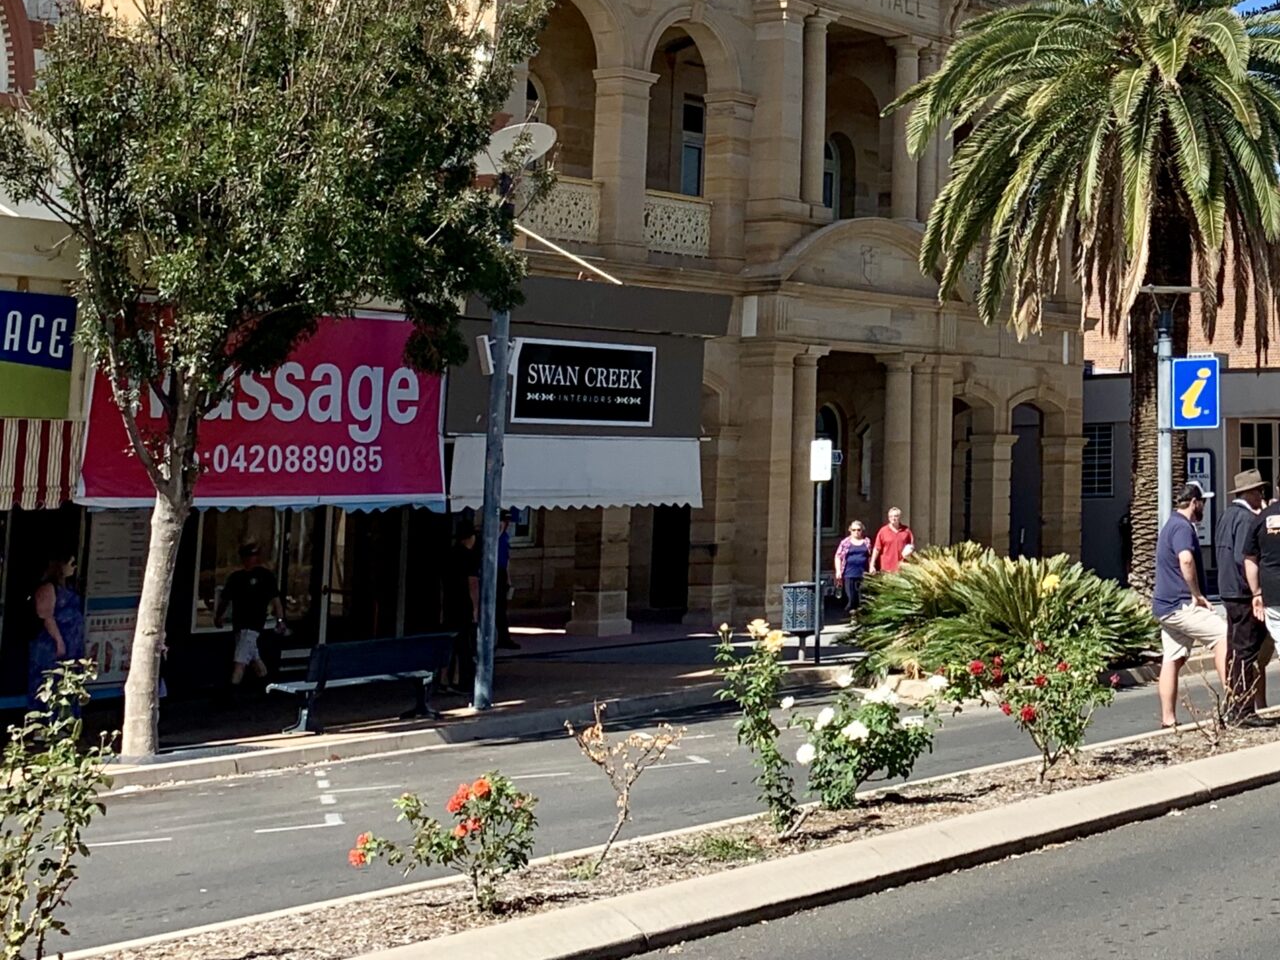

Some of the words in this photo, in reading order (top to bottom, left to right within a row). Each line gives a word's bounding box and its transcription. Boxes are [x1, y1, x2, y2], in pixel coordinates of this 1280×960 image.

[3, 310, 68, 359] ACE
[527, 363, 580, 386] SWAN
[584, 366, 643, 390] CREEK
[558, 393, 612, 404] INTERIORS
